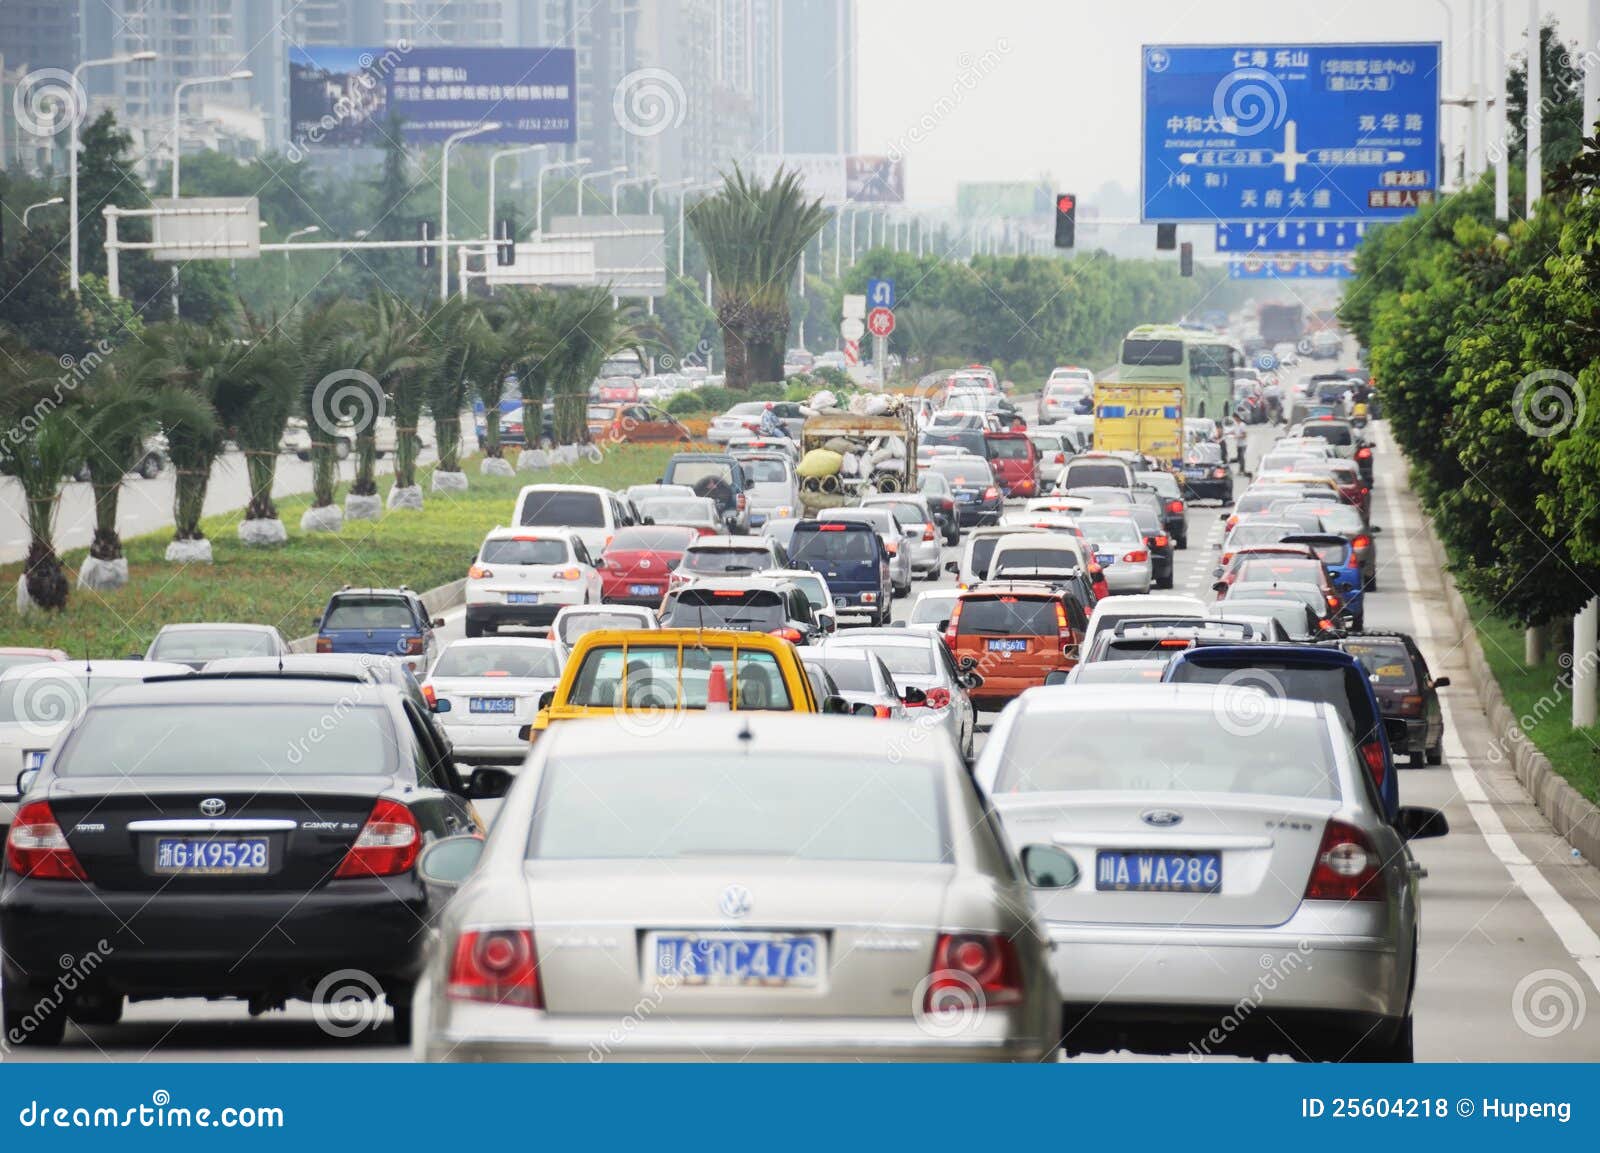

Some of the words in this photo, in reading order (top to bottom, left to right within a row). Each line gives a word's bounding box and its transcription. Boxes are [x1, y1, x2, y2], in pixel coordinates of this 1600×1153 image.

[1274, 50, 1309, 67] 乐山
[1166, 115, 1237, 133] 中和大道
[1241, 188, 1331, 208] 天府大道
[303, 821, 339, 830] CAMRY
